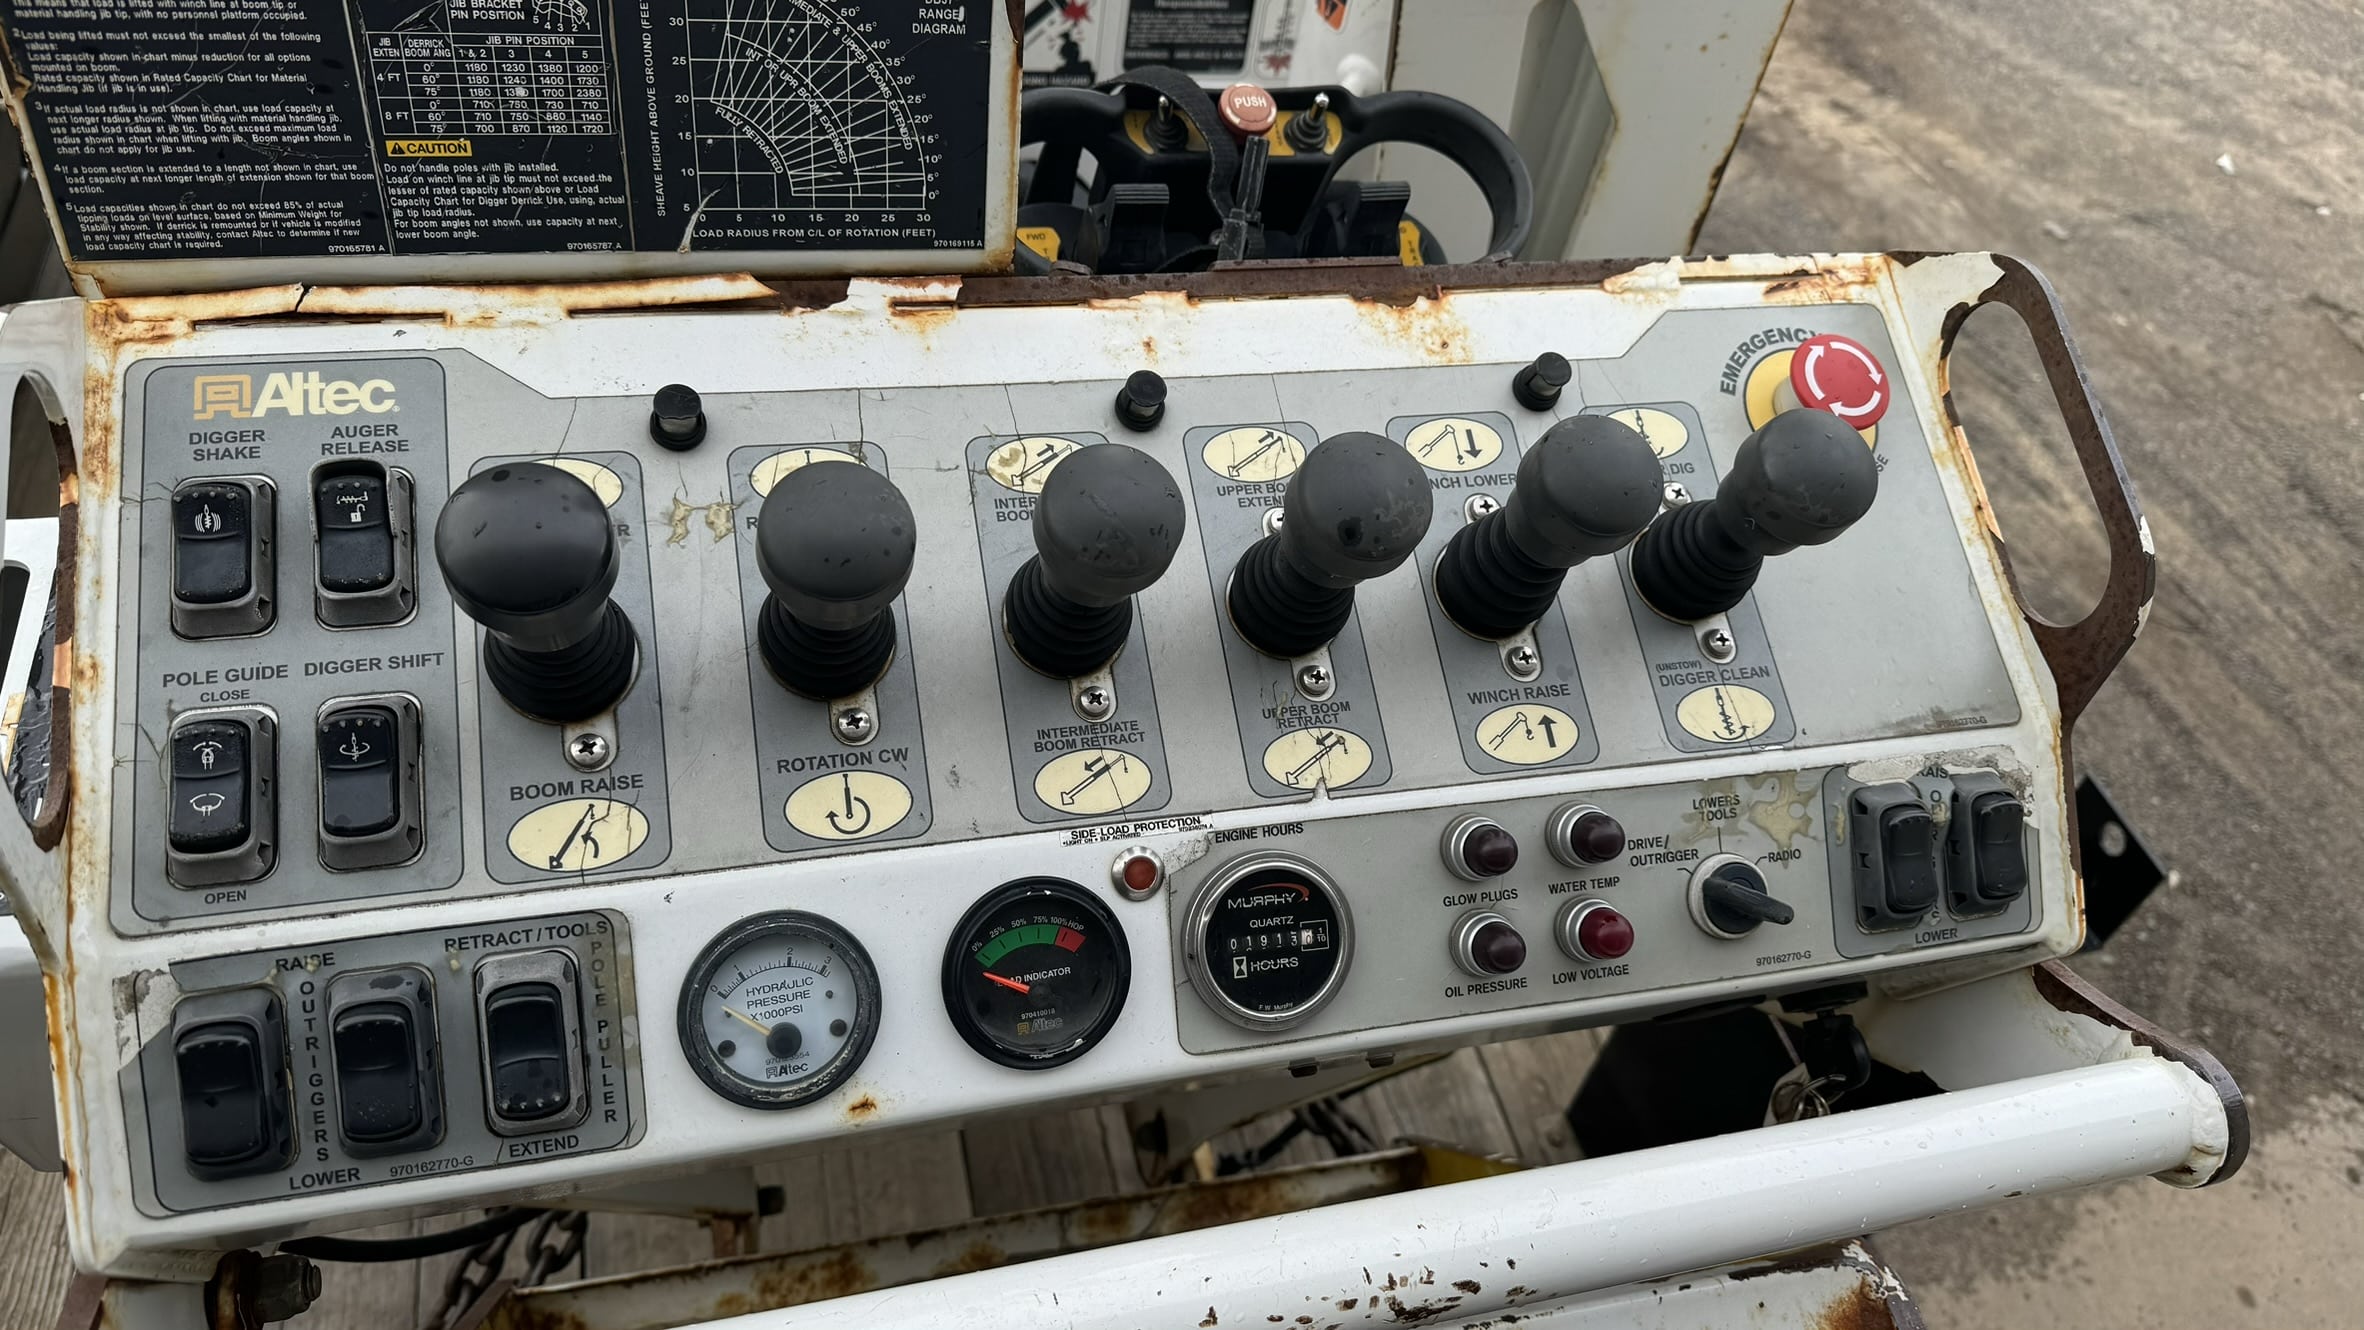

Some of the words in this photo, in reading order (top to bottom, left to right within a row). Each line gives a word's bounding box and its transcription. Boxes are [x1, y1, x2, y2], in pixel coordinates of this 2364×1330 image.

[450, 0, 466, 8] JIB
[470, 0, 522, 8] BRACKET
[451, 10, 468, 19] PIN
[472, 11, 525, 20] POSITION
[640, 0, 653, 30] (FEE
[919, 9, 959, 20] RANGE
[912, 23, 966, 34] DIAGRAM
[379, 38, 391, 46] JIB
[408, 39, 444, 48] DERRICK
[486, 36, 502, 45] JIB
[505, 37, 522, 45] PIN
[526, 37, 575, 45] POSITION
[373, 48, 400, 57] EXTEN
[405, 48, 430, 57] BOOM
[433, 49, 451, 57] ANG
[642, 32, 655, 84] GROUND
[465, 64, 488, 72] 1180
[502, 64, 525, 72] 1230
[538, 64, 562, 72] 1380
[576, 65, 599, 73] 1200
[377, 74, 384, 82] 4
[388, 74, 400, 82] FT
[540, 76, 564, 85] 1400
[577, 77, 599, 85] 1730
[542, 89, 566, 97] 1700
[577, 89, 602, 97] 2380
[647, 85, 659, 127] ABOVE
[1234, 95, 1267, 110] PUSH
[715, 106, 743, 127] FULLY
[742, 125, 784, 174] RETRACTED
[407, 142, 467, 154] CAUTION
[652, 131, 662, 170] HEIGHT
[384, 164, 397, 172] Do
[401, 164, 416, 172] not
[419, 164, 449, 172] handle
[453, 165, 477, 174] poles
[482, 163, 500, 172] with
[504, 163, 515, 173] jib
[518, 163, 559, 172] installed.
[655, 173, 666, 216] SHEAVE
[700, 214, 706, 222] 0
[736, 214, 742, 222] 5
[771, 214, 785, 222] 10
[809, 214, 822, 222] 15
[845, 214, 859, 222] 20
[881, 214, 895, 222] 25
[917, 214, 931, 222] 30
[396, 230, 420, 238] lower
[424, 230, 449, 238] boom
[453, 230, 479, 239] angle.
[693, 229, 724, 238] LOAD
[727, 229, 769, 237] RADIUS
[772, 229, 805, 237] FROM
[808, 229, 825, 238] C/L
[828, 229, 842, 237] OF
[846, 229, 899, 237] ROTATION
[902, 229, 936, 238] (FEET)
[1026, 233, 1046, 242] FWD
[251, 371, 399, 417] Altec
[189, 429, 266, 445] DIGGER
[331, 424, 399, 438] AUGER
[193, 446, 261, 461] SHAKE
[321, 440, 409, 456] RELEASE
[1672, 462, 1695, 475] DIG
[1430, 476, 1462, 490] NCH
[1464, 473, 1517, 488] LOWER
[1216, 483, 1262, 497] UPPER
[1238, 495, 1285, 509] EXTEN
[304, 657, 382, 676] DIGGER
[388, 652, 444, 669] SHIFT
[1655, 660, 1701, 674] (UNSTOW)
[163, 670, 218, 687] POLE
[225, 664, 289, 683] GUIDE
[1659, 671, 1718, 688] DIGGER
[1720, 666, 1770, 682] CLEAN
[200, 689, 250, 703] CLOSE
[1468, 688, 1520, 705] WINCH
[1525, 684, 1571, 700] RAISE
[1262, 706, 1310, 720] UPPER
[1312, 701, 1351, 715] BOOM
[1278, 713, 1340, 727] RETRACT
[1036, 720, 1139, 741] INTERMEDIATE
[1034, 737, 1078, 753] BOOM
[1080, 731, 1146, 748] RETRACT
[777, 751, 874, 774] ROTATION
[878, 747, 910, 766] CW
[510, 781, 575, 801] BOOM
[581, 774, 644, 794] RAISE
[1692, 795, 1740, 810] LOWERS
[1701, 808, 1737, 822] TOOLS
[1132, 816, 1201, 833] PROTECTION
[1215, 828, 1259, 843] ENGINE
[1262, 823, 1304, 839] HOURS
[1628, 835, 1670, 851] DRIVE/
[1630, 849, 1699, 867] OUTRIGGER
[1768, 849, 1801, 863] RADIO
[1548, 880, 1587, 894] WATER
[1590, 876, 1620, 890] TEMP
[204, 890, 247, 905] OPEN
[1228, 893, 1296, 909] MURPHY
[1443, 893, 1477, 907] GLOW
[1480, 888, 1518, 902] PLUGS
[1011, 919, 1027, 928] 50%
[1249, 916, 1294, 928] QUARTZ
[444, 929, 533, 952] RETRACT
[545, 921, 608, 940] TOOLS
[989, 926, 1005, 938] 25%
[1915, 928, 1958, 944] LOWER
[787, 947, 794, 956] 2
[971, 942, 983, 952] 0%
[275, 952, 335, 973] RAISE
[824, 956, 832, 965] 3
[1251, 957, 1298, 972] HOURS
[1756, 950, 1812, 966] 970162770-G
[1024, 967, 1071, 982] INDICATOR
[1552, 972, 1577, 984] LOW
[1580, 964, 1629, 981] VOLTAGE
[710, 984, 718, 993] 0
[746, 976, 814, 997] HYDRAULIC
[1445, 985, 1464, 998] OIL
[1467, 977, 1528, 995] PRESSURE
[746, 990, 811, 1009] PRESSURE
[300, 980, 329, 1163] OUTRIGGERS
[779, 1062, 809, 1076] Altec
[509, 1134, 579, 1158] EXTEND
[389, 1155, 474, 1178] 970162770-G
[289, 1167, 361, 1191] LOWER
